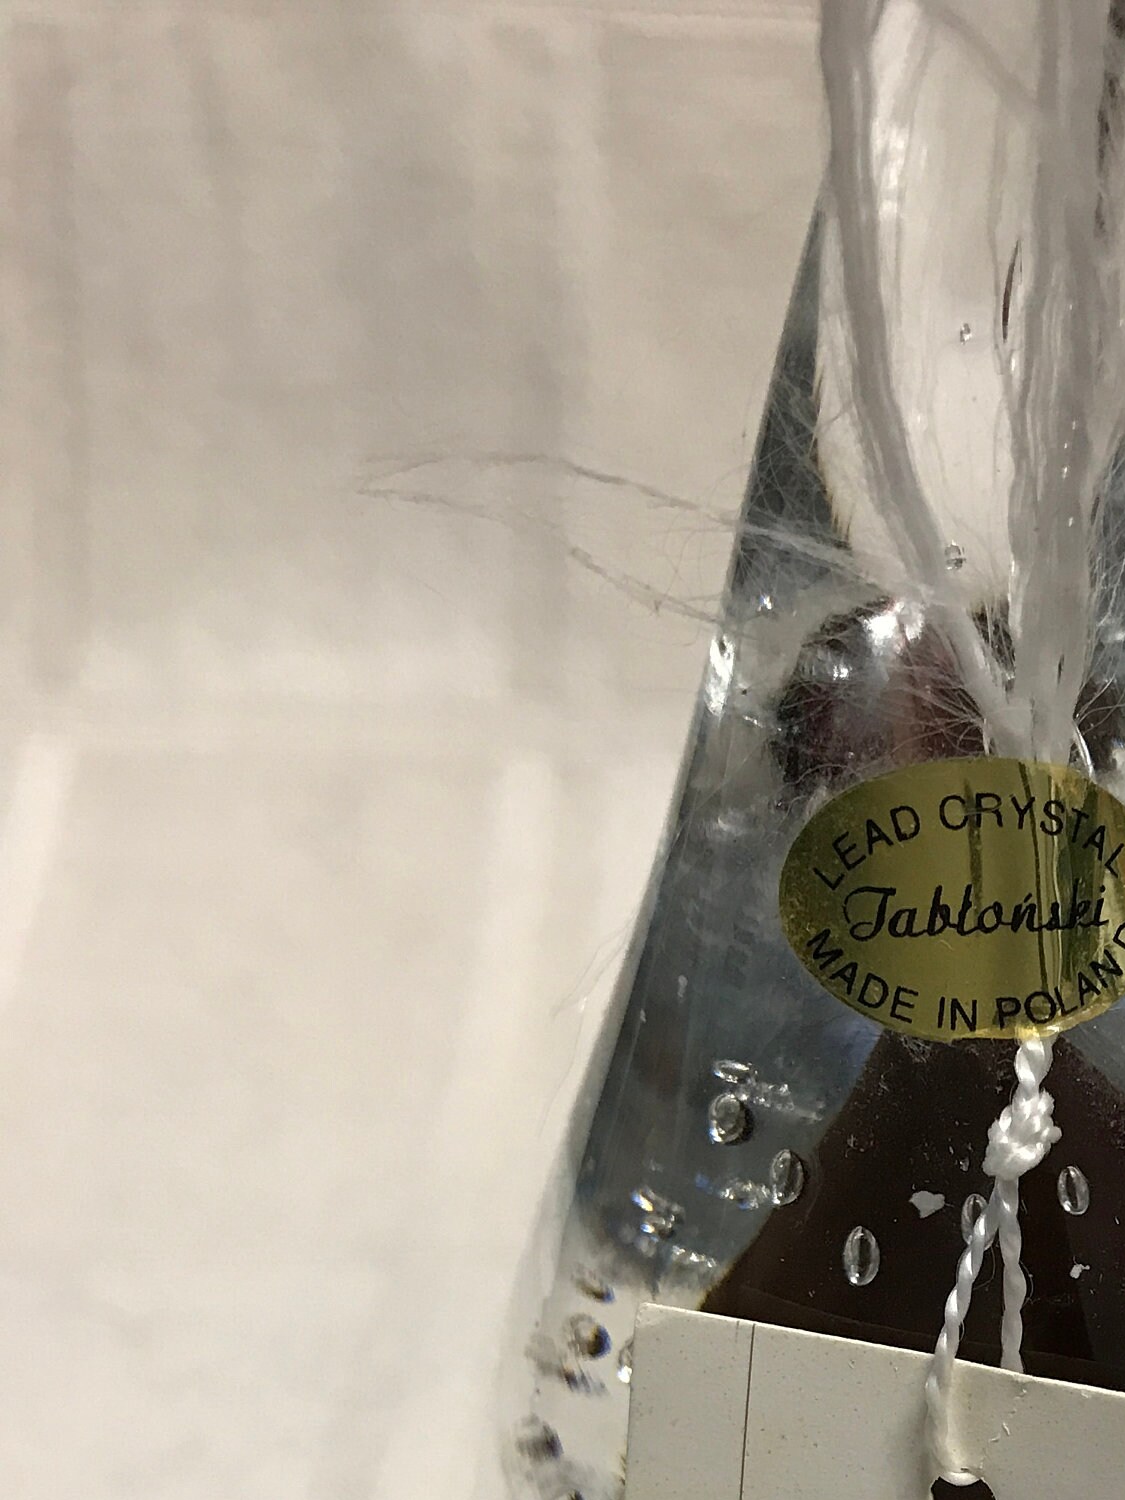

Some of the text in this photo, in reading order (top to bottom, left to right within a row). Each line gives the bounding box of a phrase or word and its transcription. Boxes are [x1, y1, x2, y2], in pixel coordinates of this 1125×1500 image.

[813, 805, 921, 891] LEAD
[807, 928, 919, 1024] MADE
[938, 997, 977, 1032] IN
